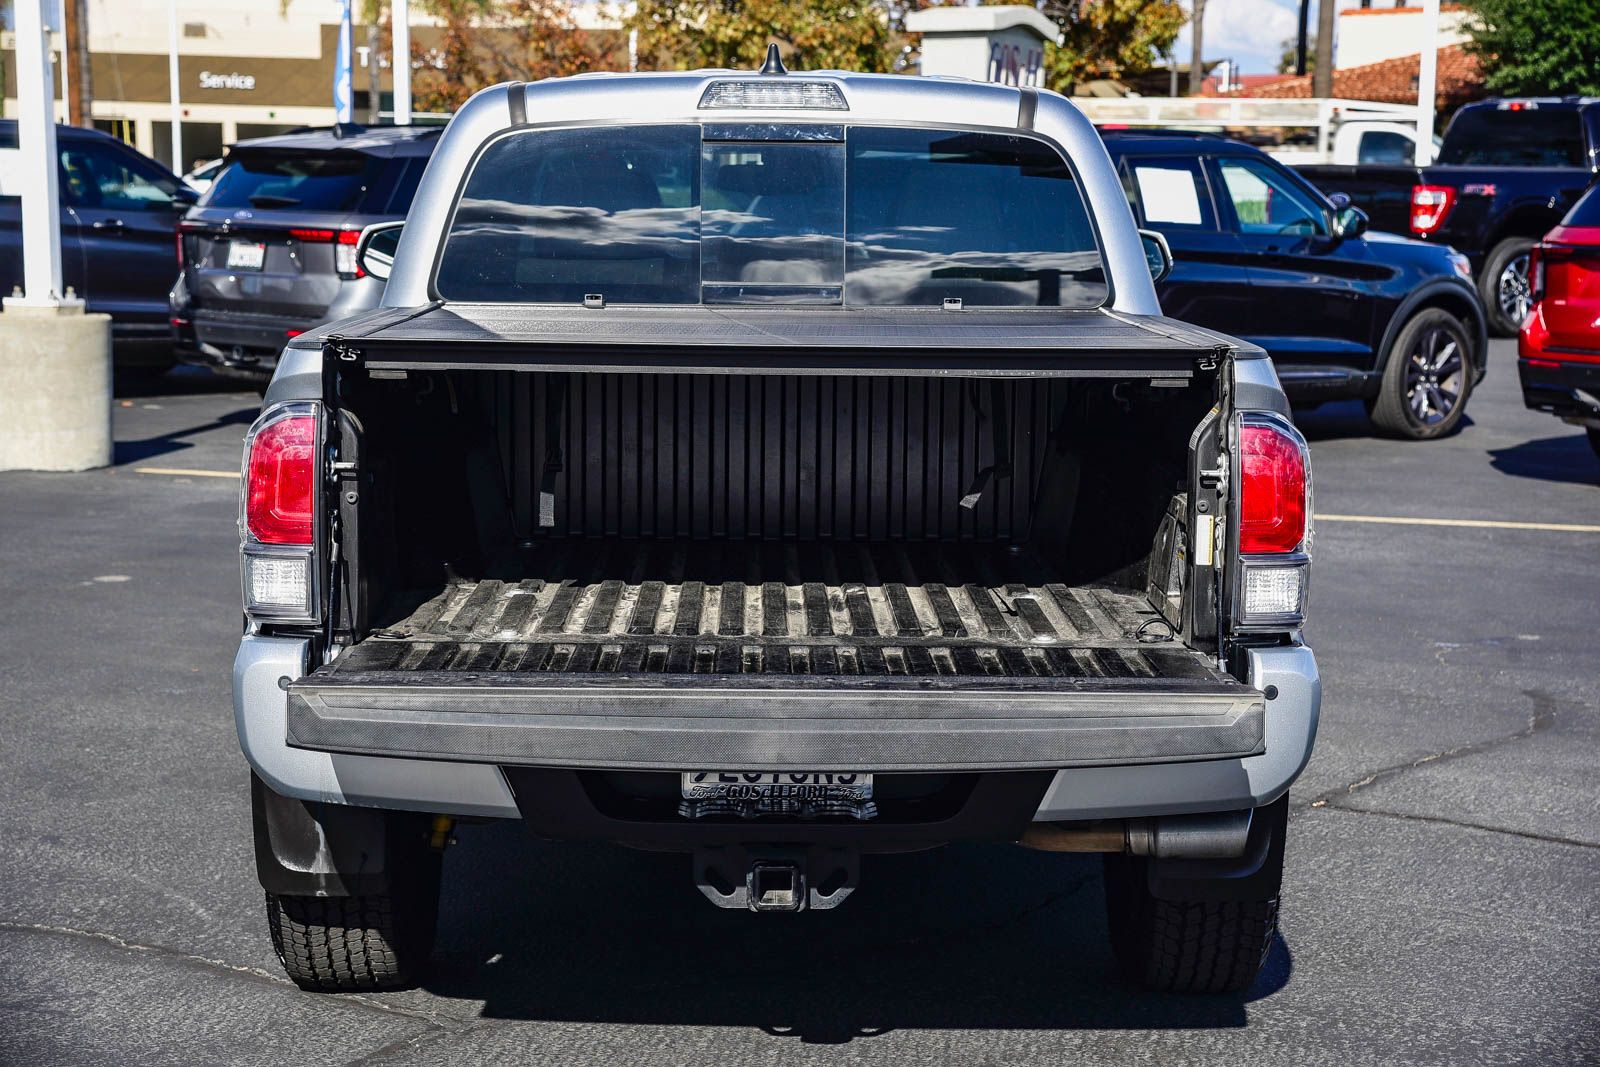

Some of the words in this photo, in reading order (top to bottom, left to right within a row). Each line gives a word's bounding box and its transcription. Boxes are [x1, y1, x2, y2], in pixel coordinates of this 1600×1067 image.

[199, 71, 255, 90] Service
[690, 786, 719, 799] Ford
[838, 786, 865, 800] Ford
